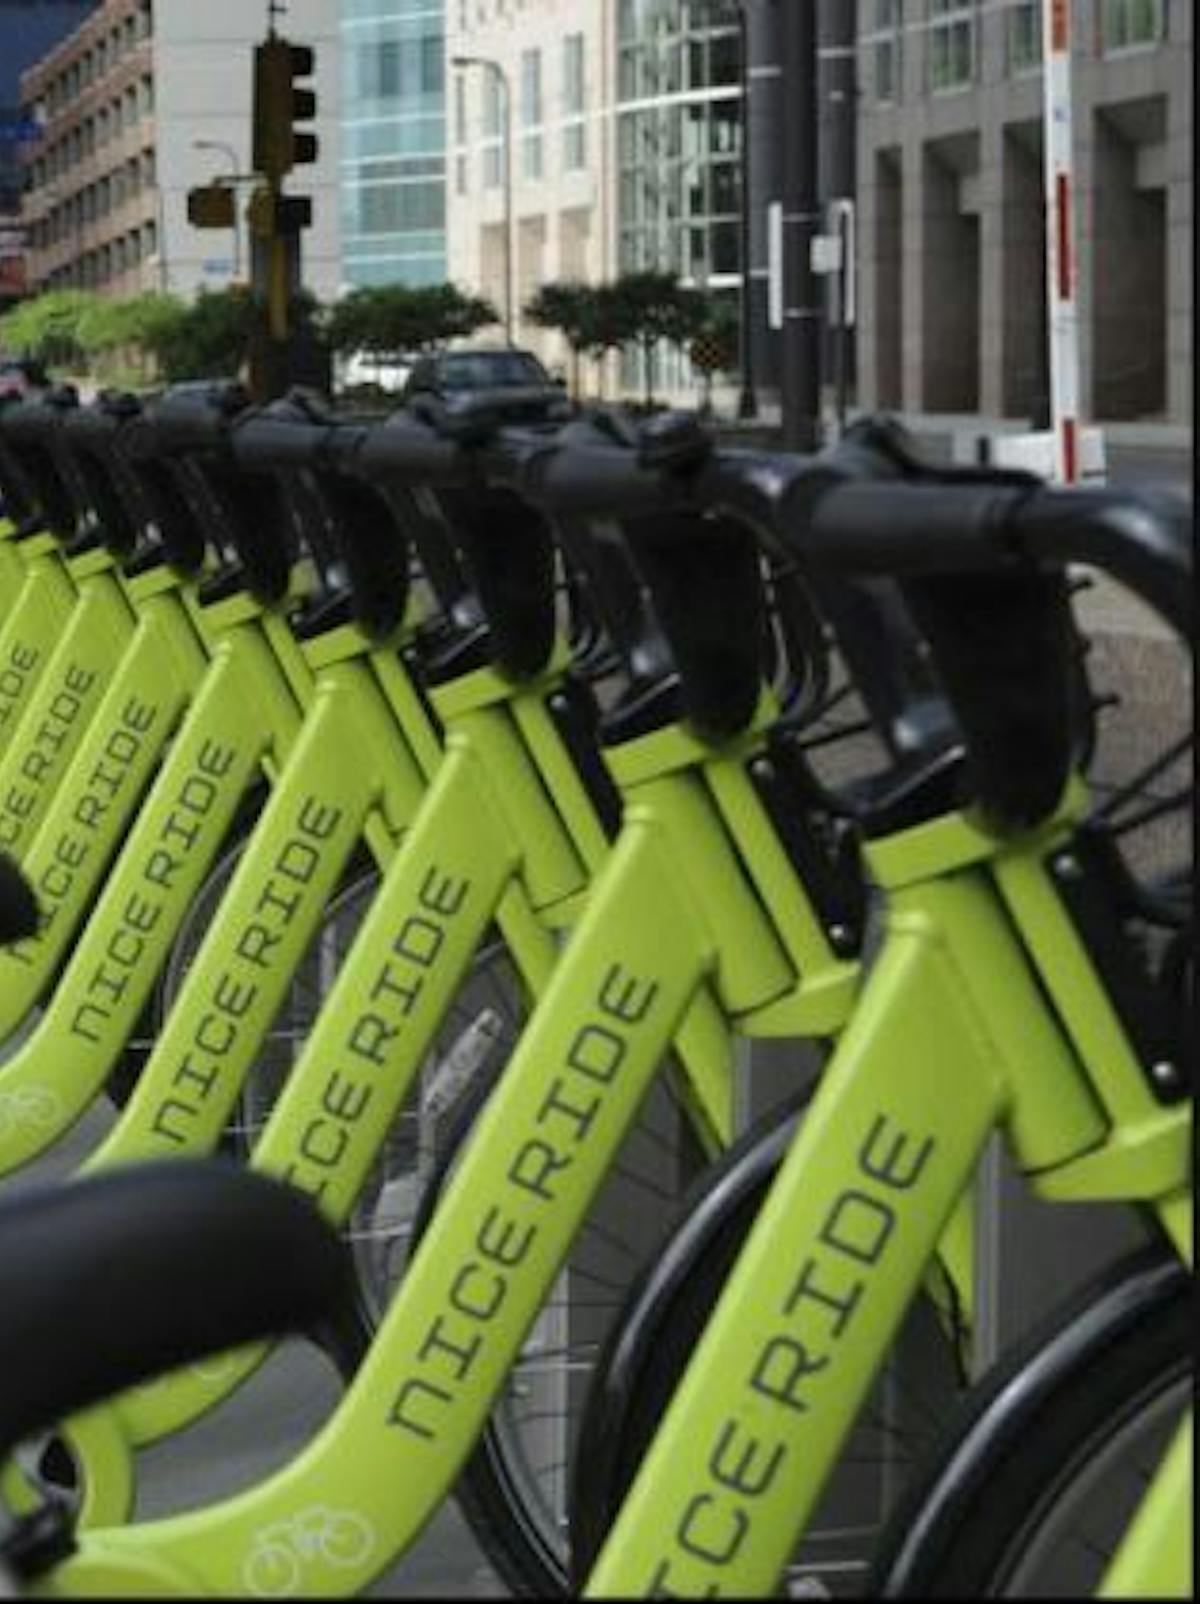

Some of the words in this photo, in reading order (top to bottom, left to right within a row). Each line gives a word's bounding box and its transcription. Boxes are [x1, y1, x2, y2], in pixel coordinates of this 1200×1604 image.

[22, 666, 95, 785] RIDE
[74, 696, 156, 830] RIDE
[72, 891, 156, 1043] NICE
[145, 739, 234, 890] RIDE
[152, 974, 258, 1143] NICE
[235, 797, 343, 969] RIDE
[286, 1070, 372, 1195] CE
[349, 865, 470, 1065] RIDE
[386, 1206, 538, 1439] NICE
[507, 963, 659, 1201] RIDE
[646, 1417, 787, 1599] CE
[749, 1112, 936, 1413] RIDE
